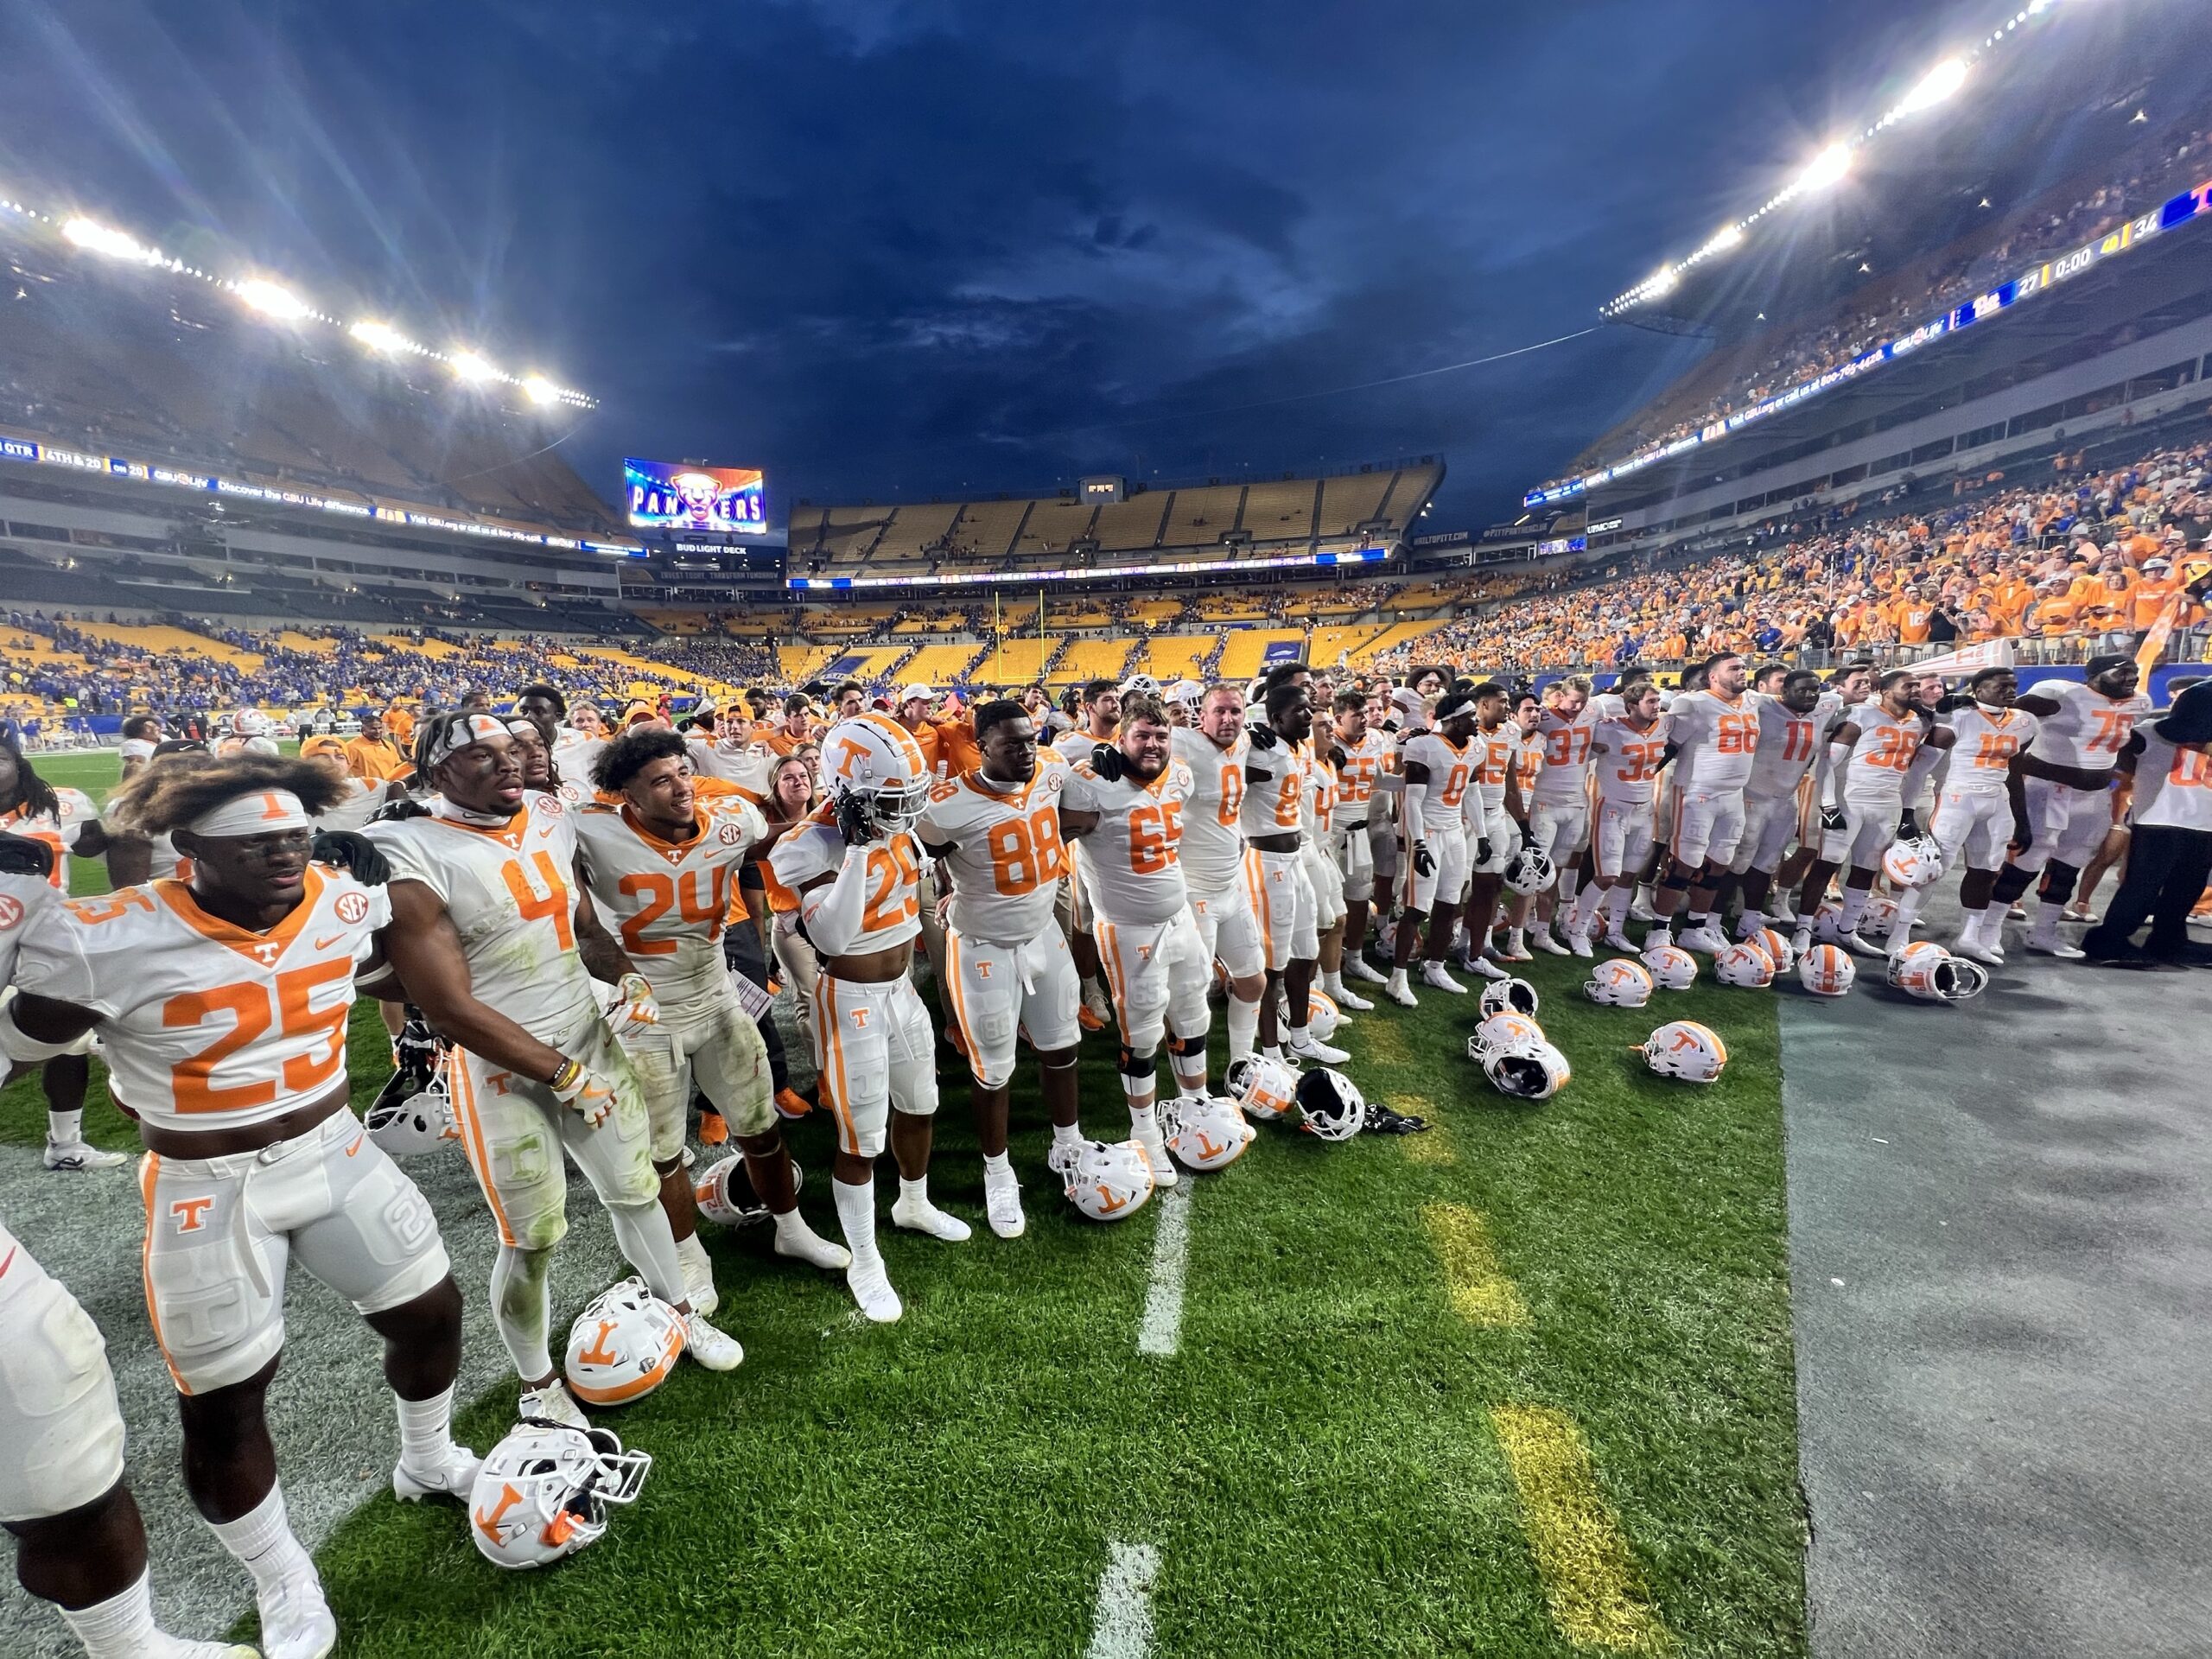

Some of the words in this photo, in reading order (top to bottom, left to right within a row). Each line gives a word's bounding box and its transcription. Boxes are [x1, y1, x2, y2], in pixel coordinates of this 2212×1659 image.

[2133, 213, 2158, 239] 34
[2055, 248, 2092, 278] 0:00
[2018, 273, 2039, 296] 27
[4, 442, 33, 457] QTR
[46, 449, 73, 465] 4TH
[73, 454, 86, 467] &
[86, 456, 102, 469] 20
[130, 465, 143, 476] 20
[219, 480, 263, 498] Discover
[264, 489, 281, 500] the
[283, 492, 304, 504] GBU
[676, 543, 696, 552] BUD
[696, 544, 722, 554] LIGHT
[722, 546, 747, 555] DECK
[1546, 726, 1591, 766] 37
[1718, 713, 1760, 754] 66
[1782, 721, 1814, 762] 11
[837, 737, 873, 779] T
[1617, 741, 1666, 782] 35
[1218, 764, 1242, 826] 0
[1442, 764, 1469, 807] 0
[503, 832, 520, 849] T
[720, 824, 741, 845] SEC
[1128, 801, 1185, 875] 65
[666, 849, 683, 863] T
[988, 804, 1062, 896] 88
[338, 896, 368, 922] SEC
[501, 849, 575, 951] 4
[619, 866, 726, 956] 24
[1195, 901, 1207, 914] T
[1878, 903, 1899, 918] T
[254, 942, 280, 964] T
[1136, 945, 1152, 961] T
[1662, 952, 1683, 969] T
[1727, 948, 1750, 965] T
[976, 961, 992, 979] T
[1611, 966, 1632, 987] T
[851, 1008, 869, 1028] T
[162, 954, 353, 1115] 25
[1669, 1030, 1699, 1052] T
[484, 1071, 512, 1096] T
[1195, 1131, 1224, 1161] T
[1096, 1185, 1128, 1214] T
[173, 1198, 213, 1233] T
[577, 1319, 620, 1366] T
[475, 1483, 524, 1548] T
